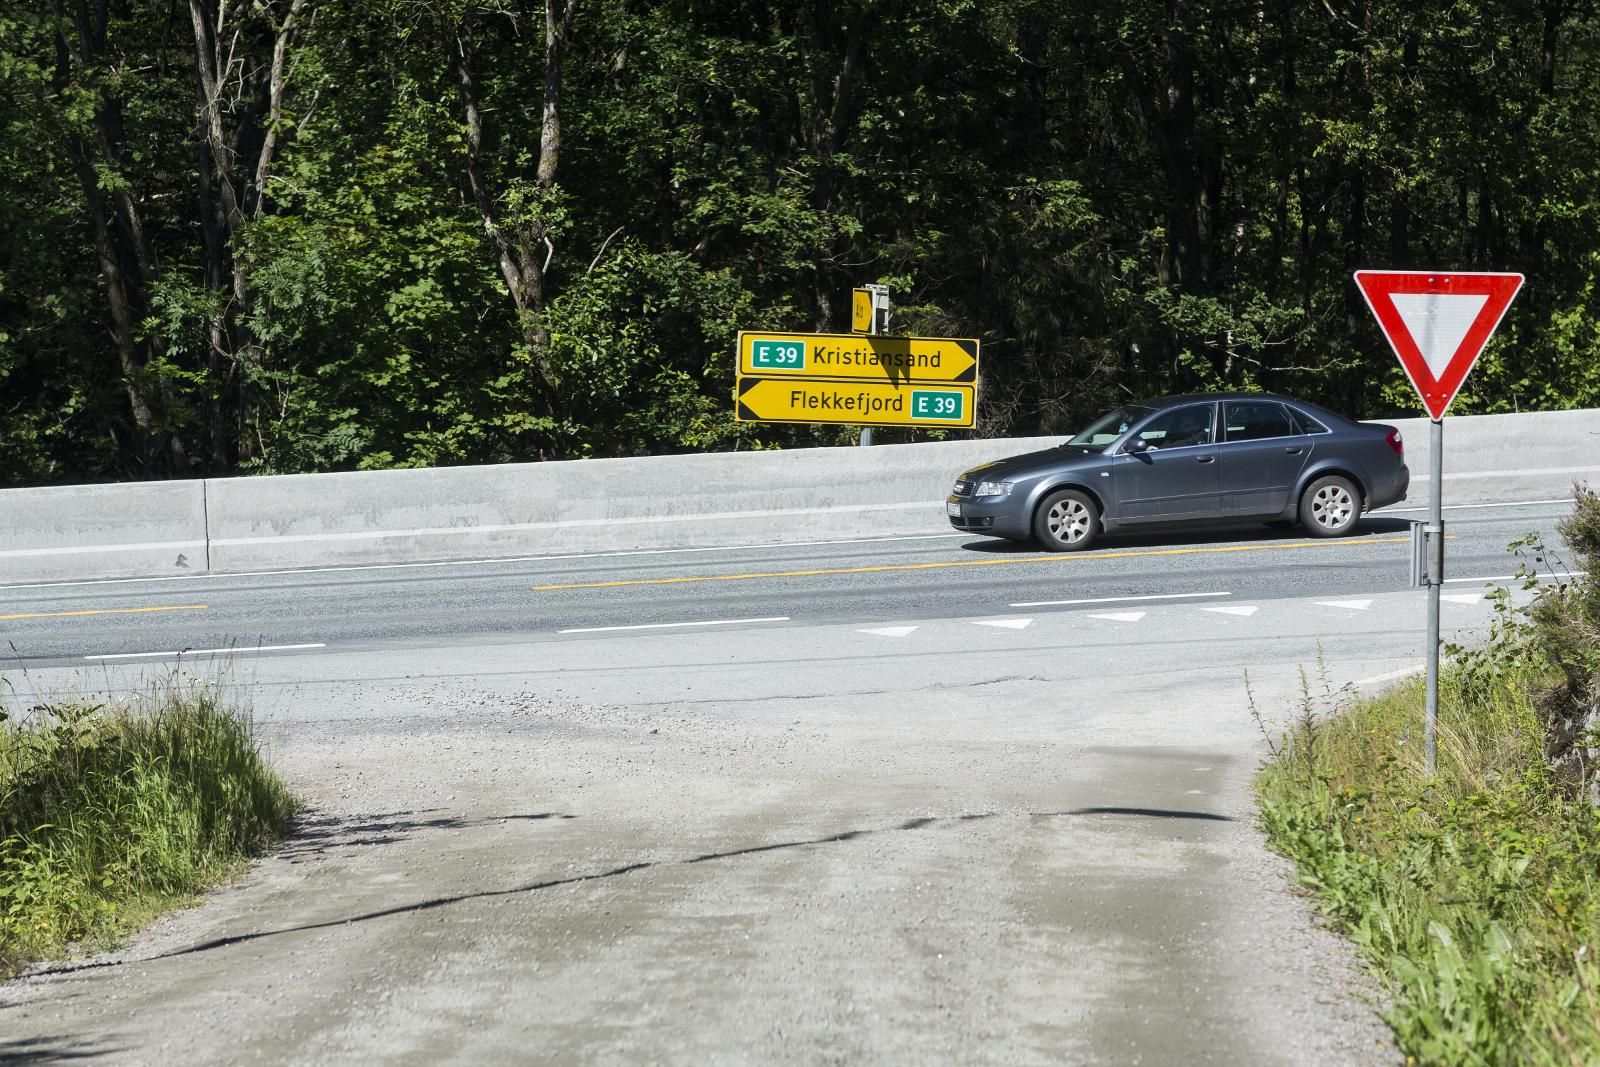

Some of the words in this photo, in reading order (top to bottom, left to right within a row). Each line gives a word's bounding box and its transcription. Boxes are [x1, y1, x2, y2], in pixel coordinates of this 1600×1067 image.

[759, 347, 770, 363] E
[775, 347, 798, 364] 39
[813, 346, 941, 368] Kristiansand
[790, 390, 903, 415] Flekkefjord
[918, 397, 929, 413] E
[934, 397, 956, 414] 39
